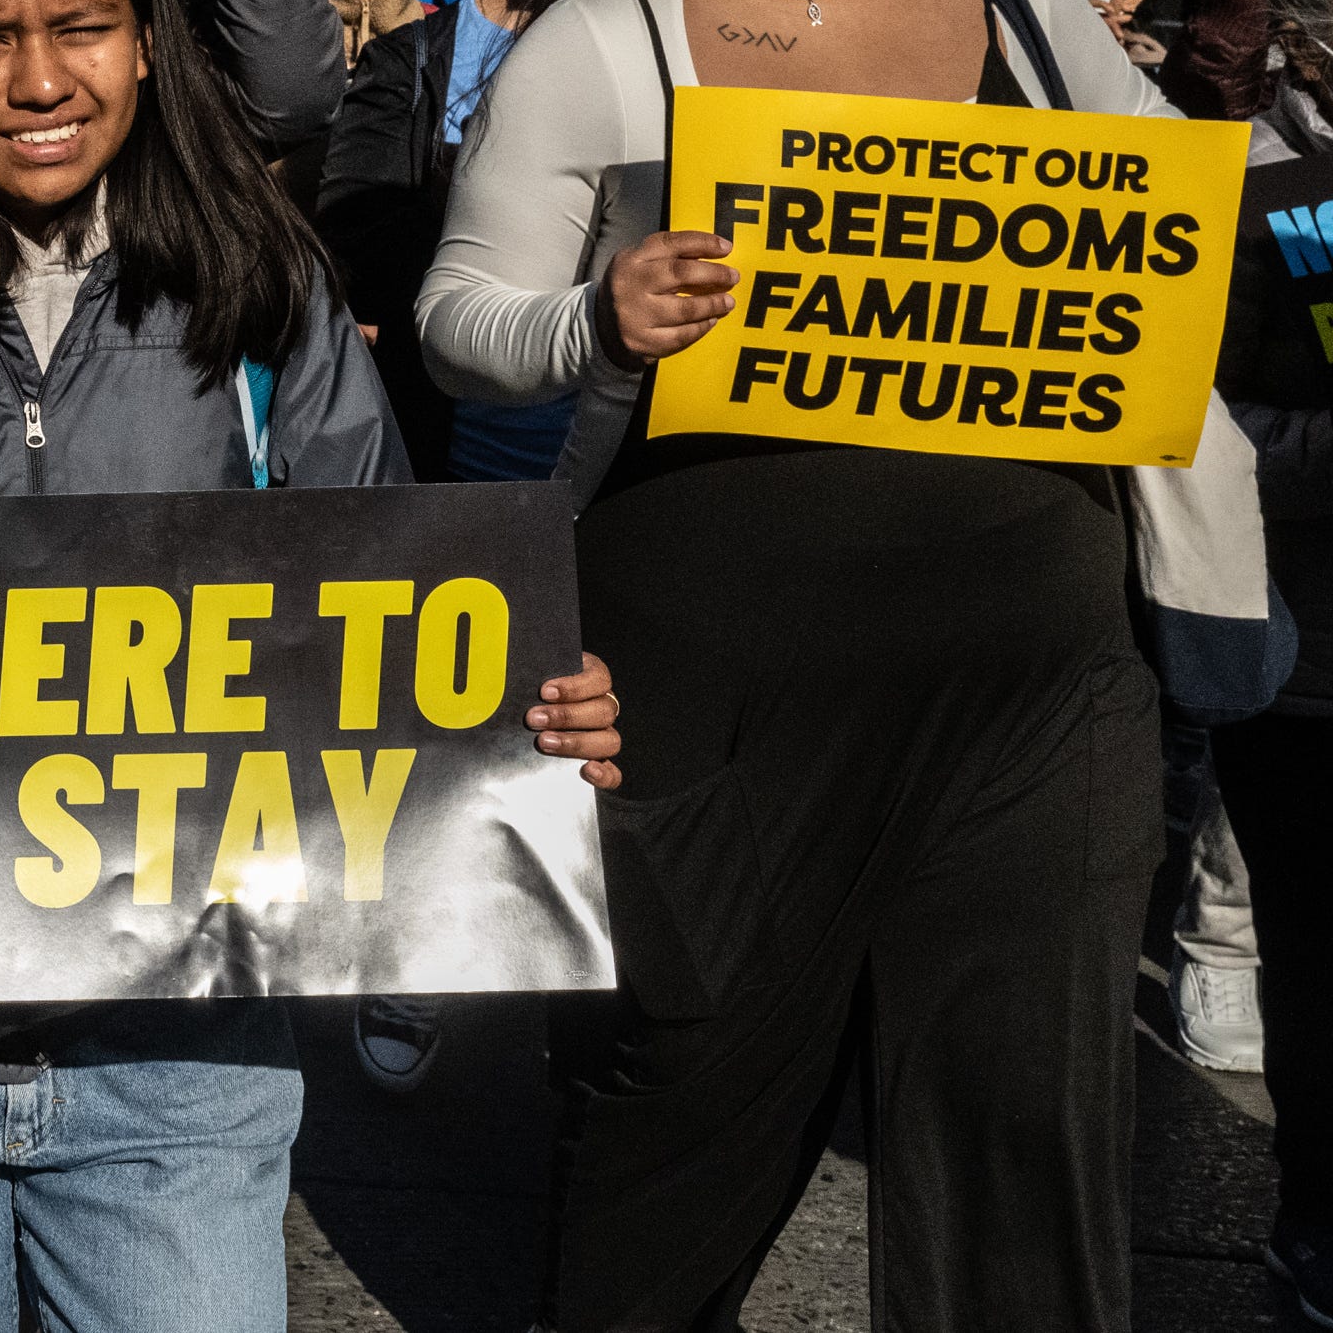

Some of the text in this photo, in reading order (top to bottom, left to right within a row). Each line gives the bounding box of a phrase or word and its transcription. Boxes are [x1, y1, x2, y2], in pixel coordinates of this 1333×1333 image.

[780, 129, 1150, 194] PROTECT OUR
[713, 182, 1201, 276] FREEDOMS
[743, 273, 1143, 356] FAMILIES
[729, 346, 1125, 433] FUTURES
[318, 576, 510, 730] TO
[14, 748, 418, 910] STAY
